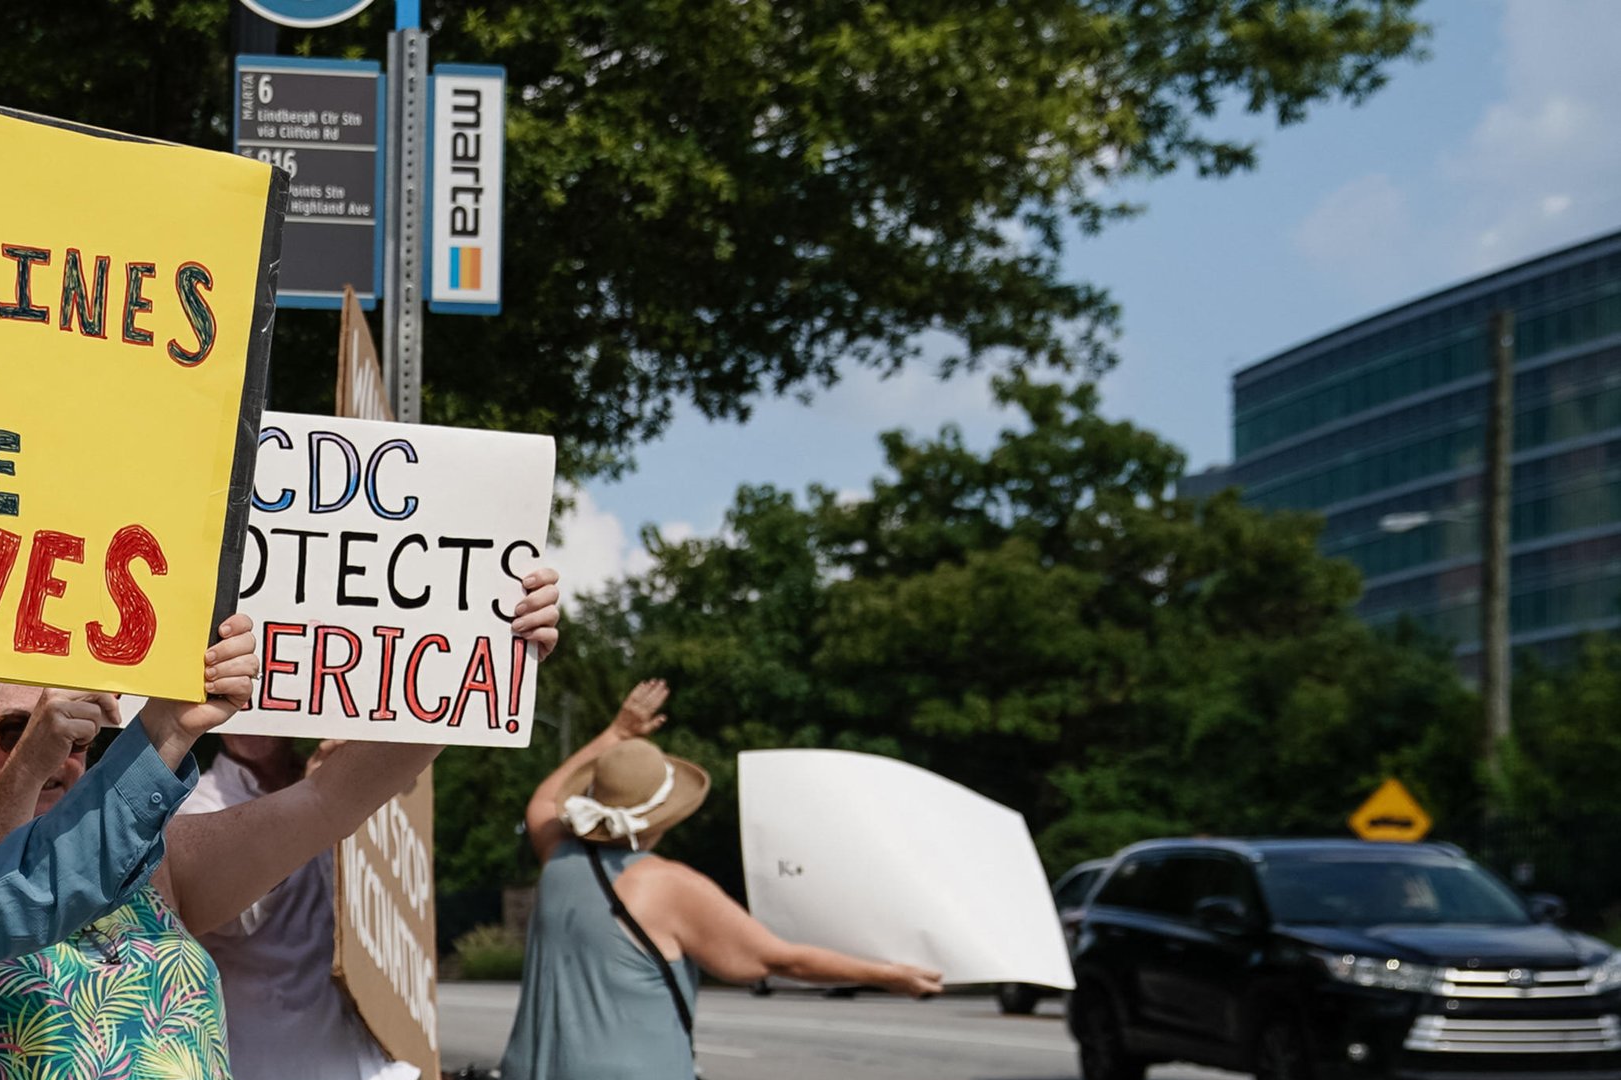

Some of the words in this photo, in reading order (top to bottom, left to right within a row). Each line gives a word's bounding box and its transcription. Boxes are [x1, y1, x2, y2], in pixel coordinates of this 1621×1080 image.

[242, 74, 254, 120] MARTA
[258, 74, 273, 104] 6
[257, 109, 318, 126] Lindbergh
[342, 112, 362, 126] Stn
[257, 125, 276, 138] via
[279, 126, 320, 139] Clifton
[323, 127, 340, 140] Rd
[450, 88, 483, 238] marta
[325, 185, 345, 199] Stn
[291, 201, 345, 216] Highland
[348, 202, 371, 216] Ave
[251, 427, 419, 521] CDC
[240, 621, 527, 734] ERICA!
